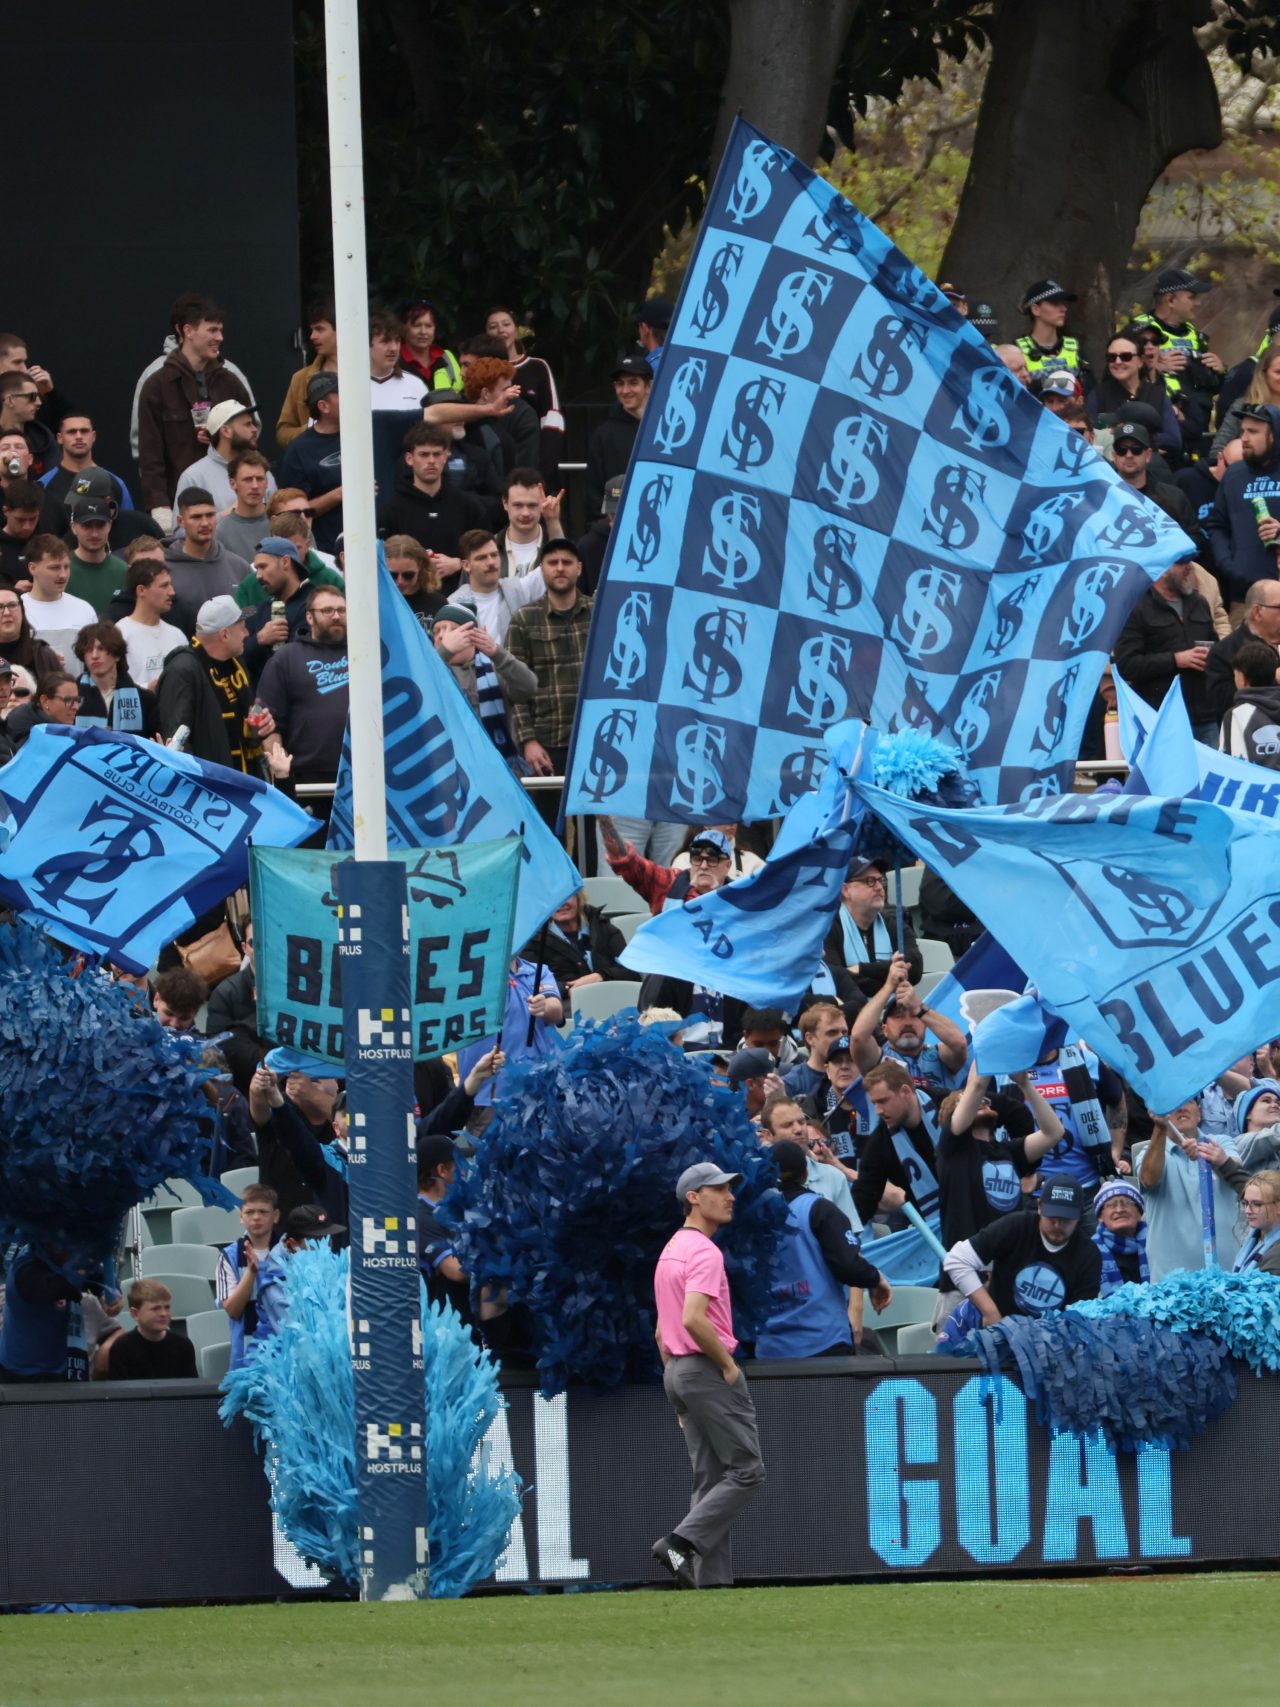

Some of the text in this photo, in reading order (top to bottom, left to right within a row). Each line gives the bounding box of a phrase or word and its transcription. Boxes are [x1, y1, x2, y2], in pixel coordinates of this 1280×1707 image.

[359, 1049, 411, 1059] HOSTPLUS
[363, 1257, 416, 1268] HOSTPLUS
[367, 1463, 421, 1473] HOSTPLUS
[864, 1375, 1192, 1566] GOAL
